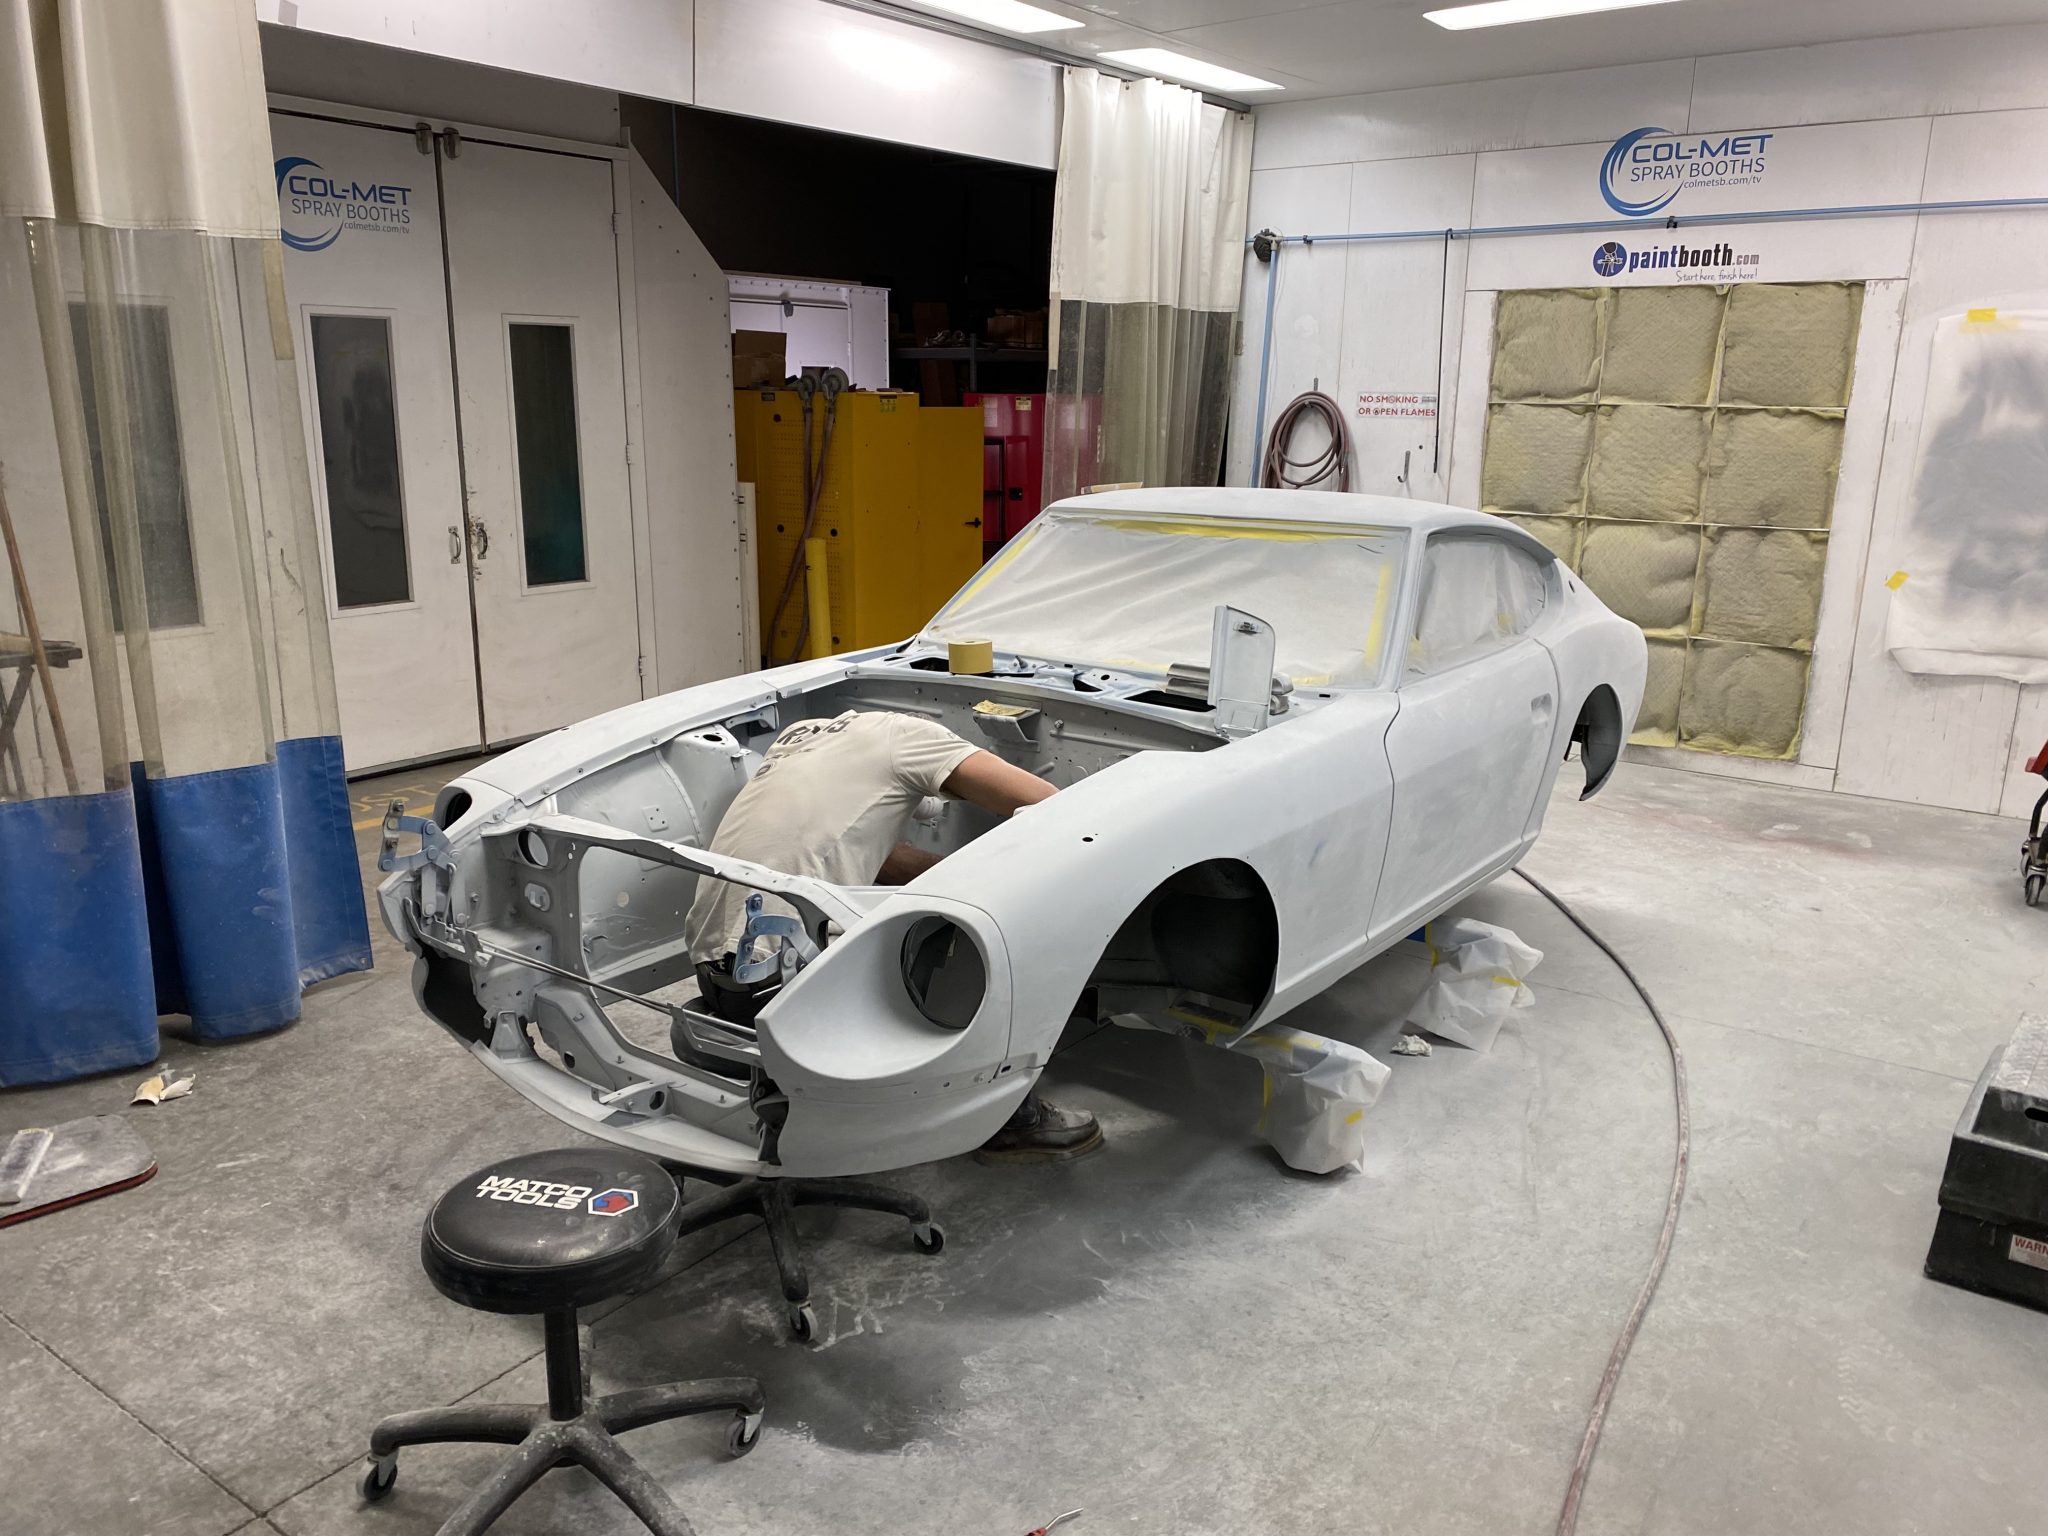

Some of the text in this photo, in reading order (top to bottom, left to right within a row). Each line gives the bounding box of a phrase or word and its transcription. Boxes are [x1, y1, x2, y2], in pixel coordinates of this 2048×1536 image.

[1631, 134, 1774, 164] COL-MET
[1630, 157, 1765, 182] SPRAY BOOTHS
[288, 175, 412, 206] COL-MET
[1683, 176, 1762, 189] colmetsb.com/tv
[291, 198, 411, 224] SPRAY BOOTHS
[344, 221, 410, 234] colmetsb.com/tv
[1628, 243, 1760, 273] paintbooth.com
[1676, 270, 1699, 283] Start
[1718, 268, 1738, 281] finish
[1738, 267, 1758, 280] here!
[1359, 395, 1374, 403] NO
[1375, 395, 1419, 404] SMOKING
[1358, 407, 1436, 417] OR OPEN FLAMES
[475, 1185, 582, 1210] TOOLS
[479, 1175, 592, 1199] MATCO
